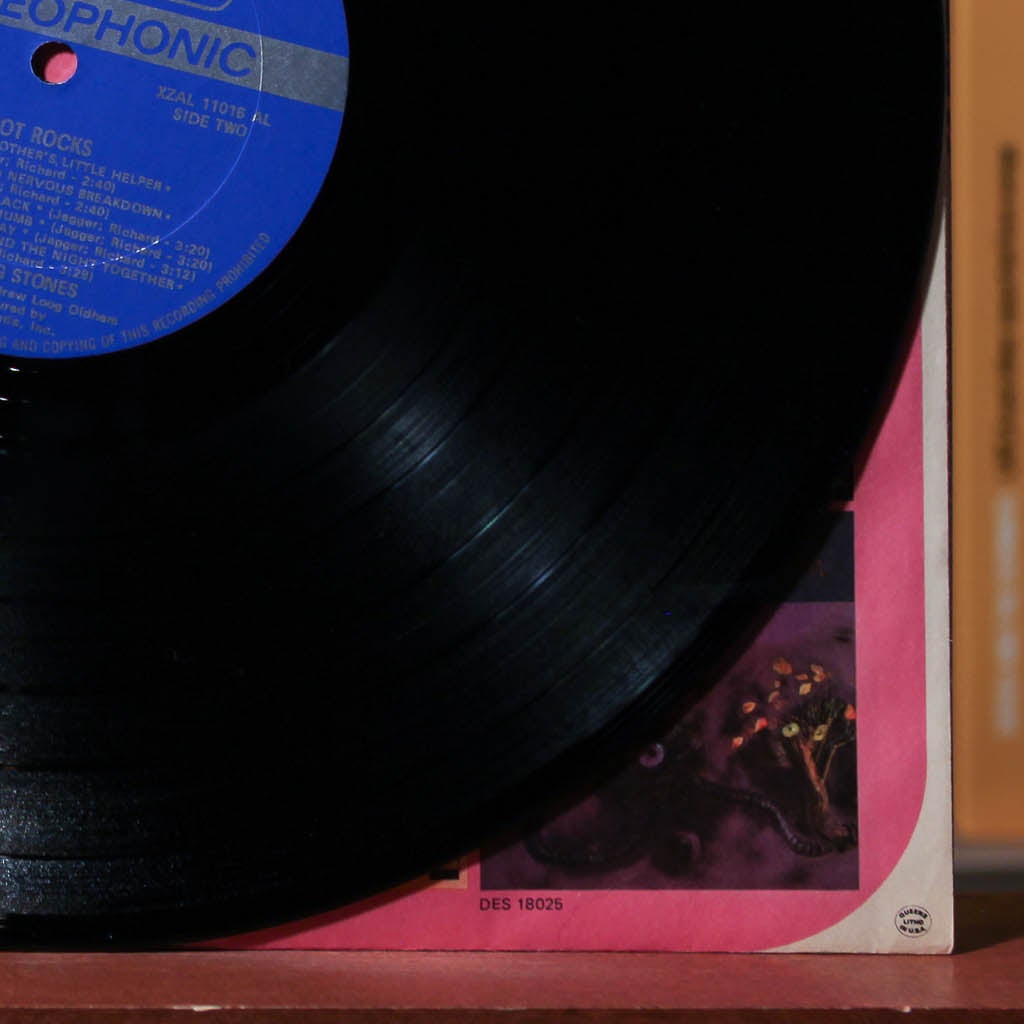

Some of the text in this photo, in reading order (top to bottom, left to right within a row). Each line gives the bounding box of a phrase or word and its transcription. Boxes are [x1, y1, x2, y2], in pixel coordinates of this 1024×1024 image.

[172, 107, 248, 138] SIDE TWO
[30, 125, 95, 158] ROCKS
[16, 159, 67, 180] Richard
[62, 157, 107, 178] LITTLE
[7, 170, 74, 196] NERVOUS
[10, 184, 60, 206] Richard
[21, 241, 48, 257] THE
[52, 250, 96, 270] NIGHT
[109, 223, 161, 245] Richard
[174, 240, 211, 260] 3:20)
[111, 237, 162, 259] Richard
[177, 254, 213, 273] 3:20)
[94, 247, 146, 268] Richard
[10, 268, 80, 300] STONES
[12, 339, 38, 353] AND
[43, 337, 97, 354] COPYING
[101, 334, 116, 348] OF
[121, 323, 150, 342] THIS
[152, 288, 217, 332] RECORDING
[215, 232, 271, 293] PROHIBITED
[480, 898, 563, 911] DES 18025
